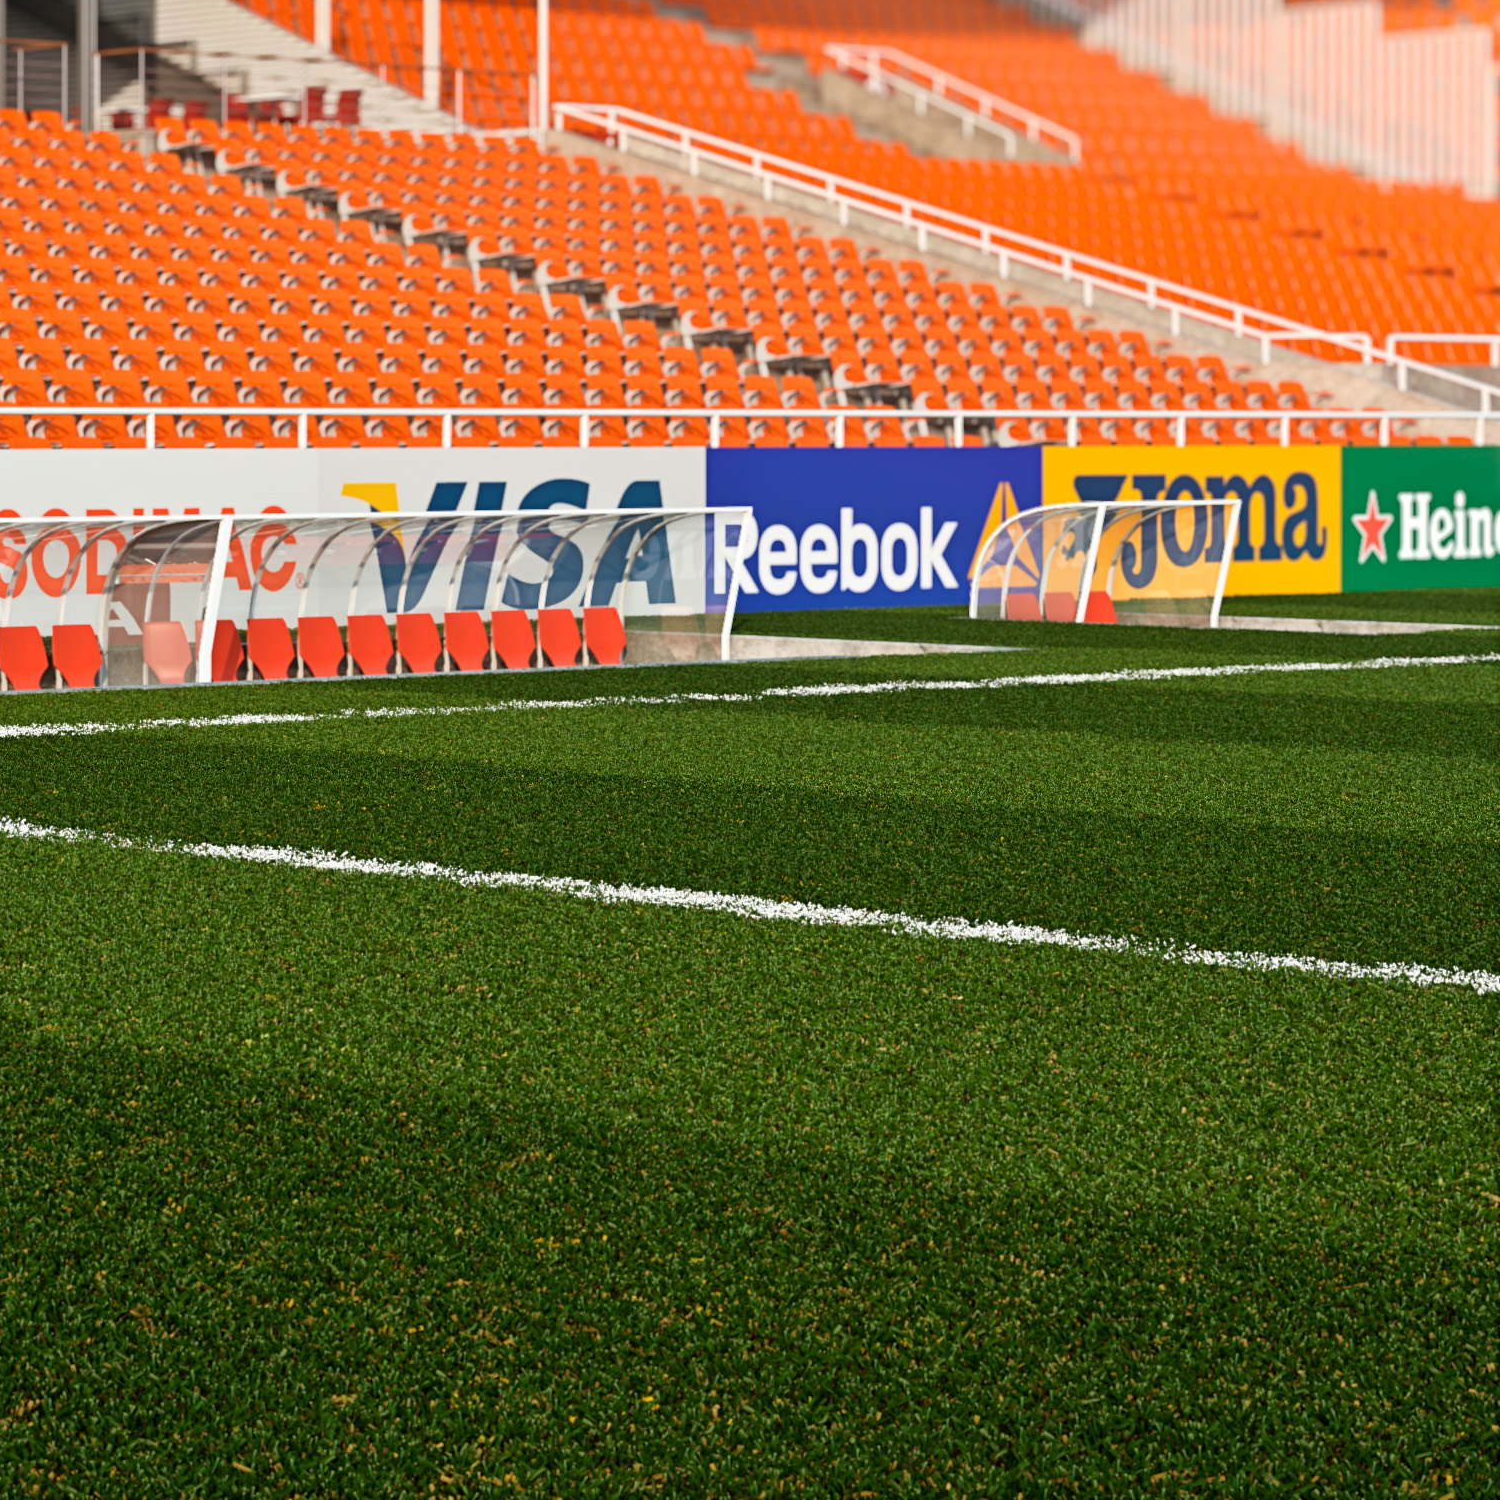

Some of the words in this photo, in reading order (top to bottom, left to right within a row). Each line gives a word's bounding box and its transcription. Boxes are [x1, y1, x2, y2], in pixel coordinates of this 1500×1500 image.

[341, 478, 676, 613] VISA
[713, 505, 959, 596] Reebok
[1119, 471, 1327, 590] Joma
[1396, 489, 1500, 561] Hein
